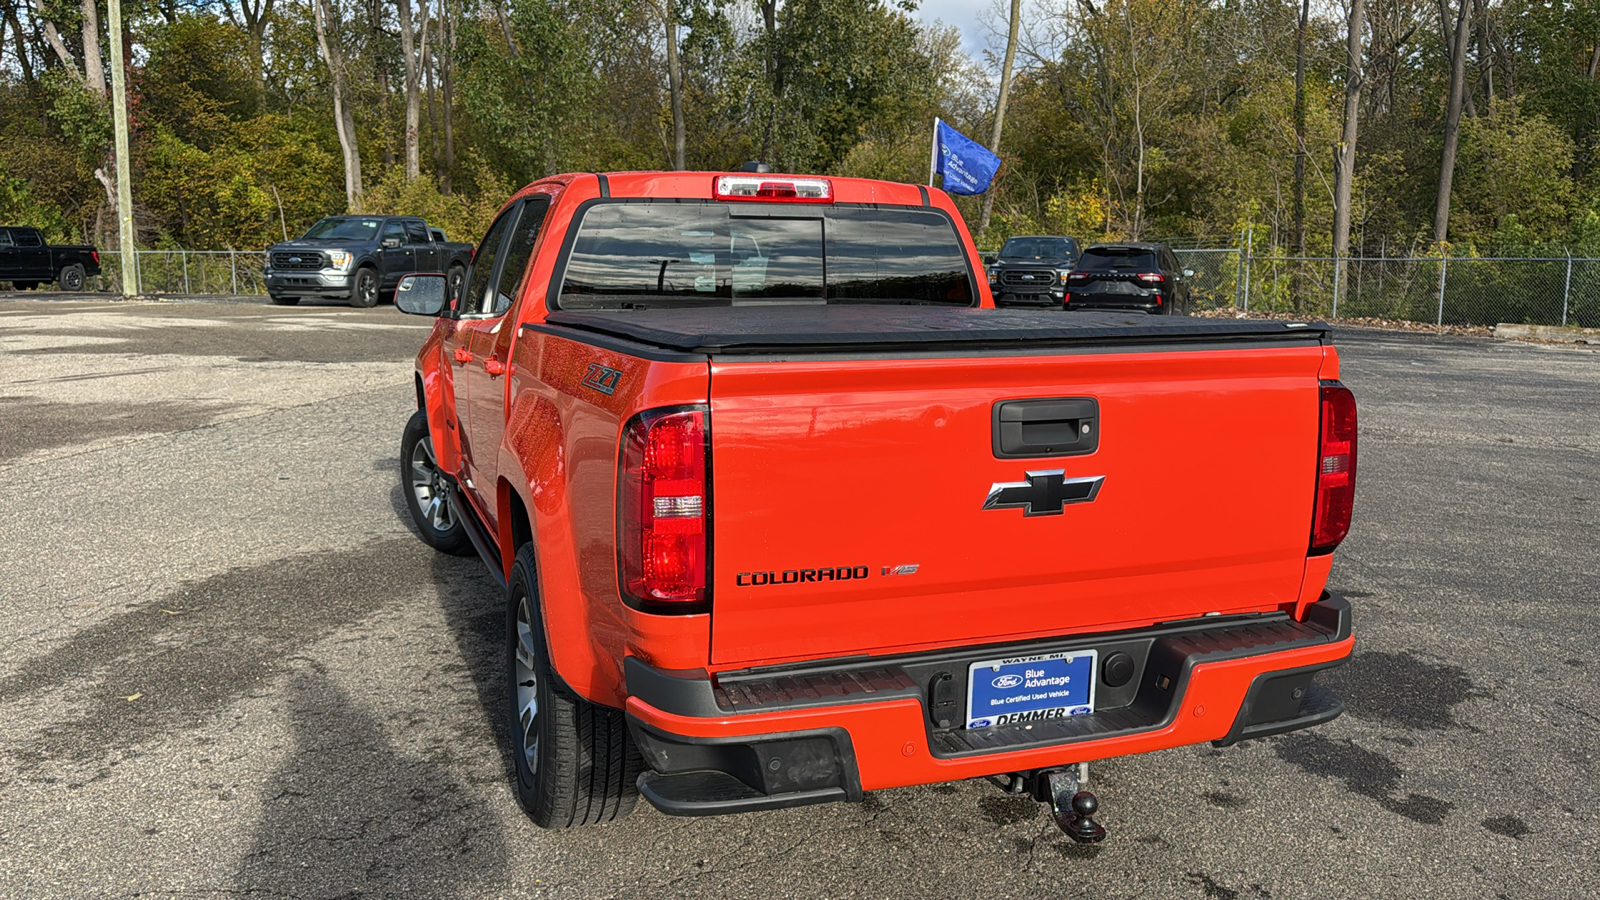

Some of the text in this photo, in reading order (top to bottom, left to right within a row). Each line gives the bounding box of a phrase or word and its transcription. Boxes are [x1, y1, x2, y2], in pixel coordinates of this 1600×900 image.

[948, 161, 978, 185] Advantage
[581, 363, 623, 396] Z71
[736, 564, 920, 587] COLORADO V6
[997, 676, 1018, 687] Ford
[1024, 676, 1070, 688] Advantage
[1025, 669, 1045, 679] Blue
[990, 690, 1070, 706] Blue Certified Used Vehicle
[996, 708, 1065, 725] DEMMER
